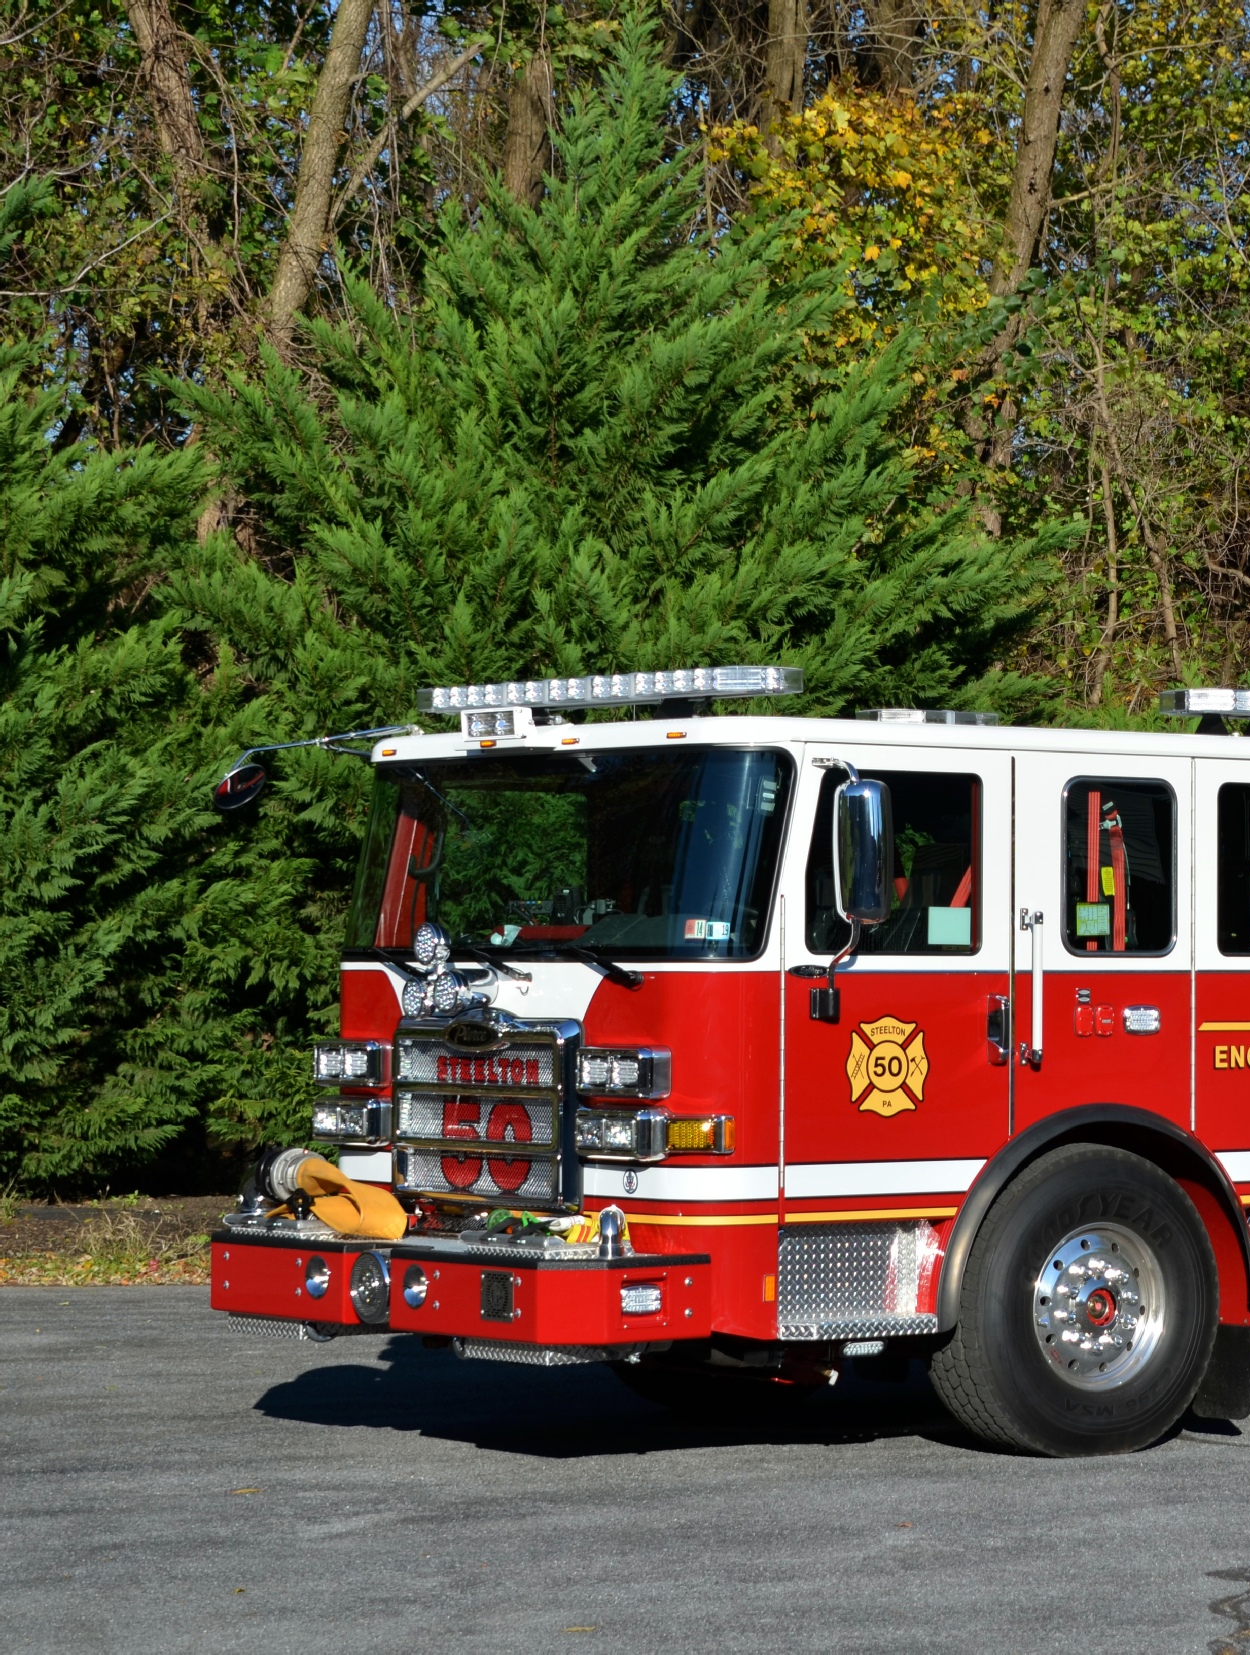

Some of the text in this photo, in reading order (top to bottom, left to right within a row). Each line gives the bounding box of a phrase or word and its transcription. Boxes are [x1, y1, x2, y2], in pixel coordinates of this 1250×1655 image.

[870, 1026, 906, 1037] STEELTON
[436, 1055, 540, 1085] STEELTON
[873, 1056, 903, 1077] 50
[882, 1100, 892, 1108] PA
[440, 1099, 533, 1192] 50
